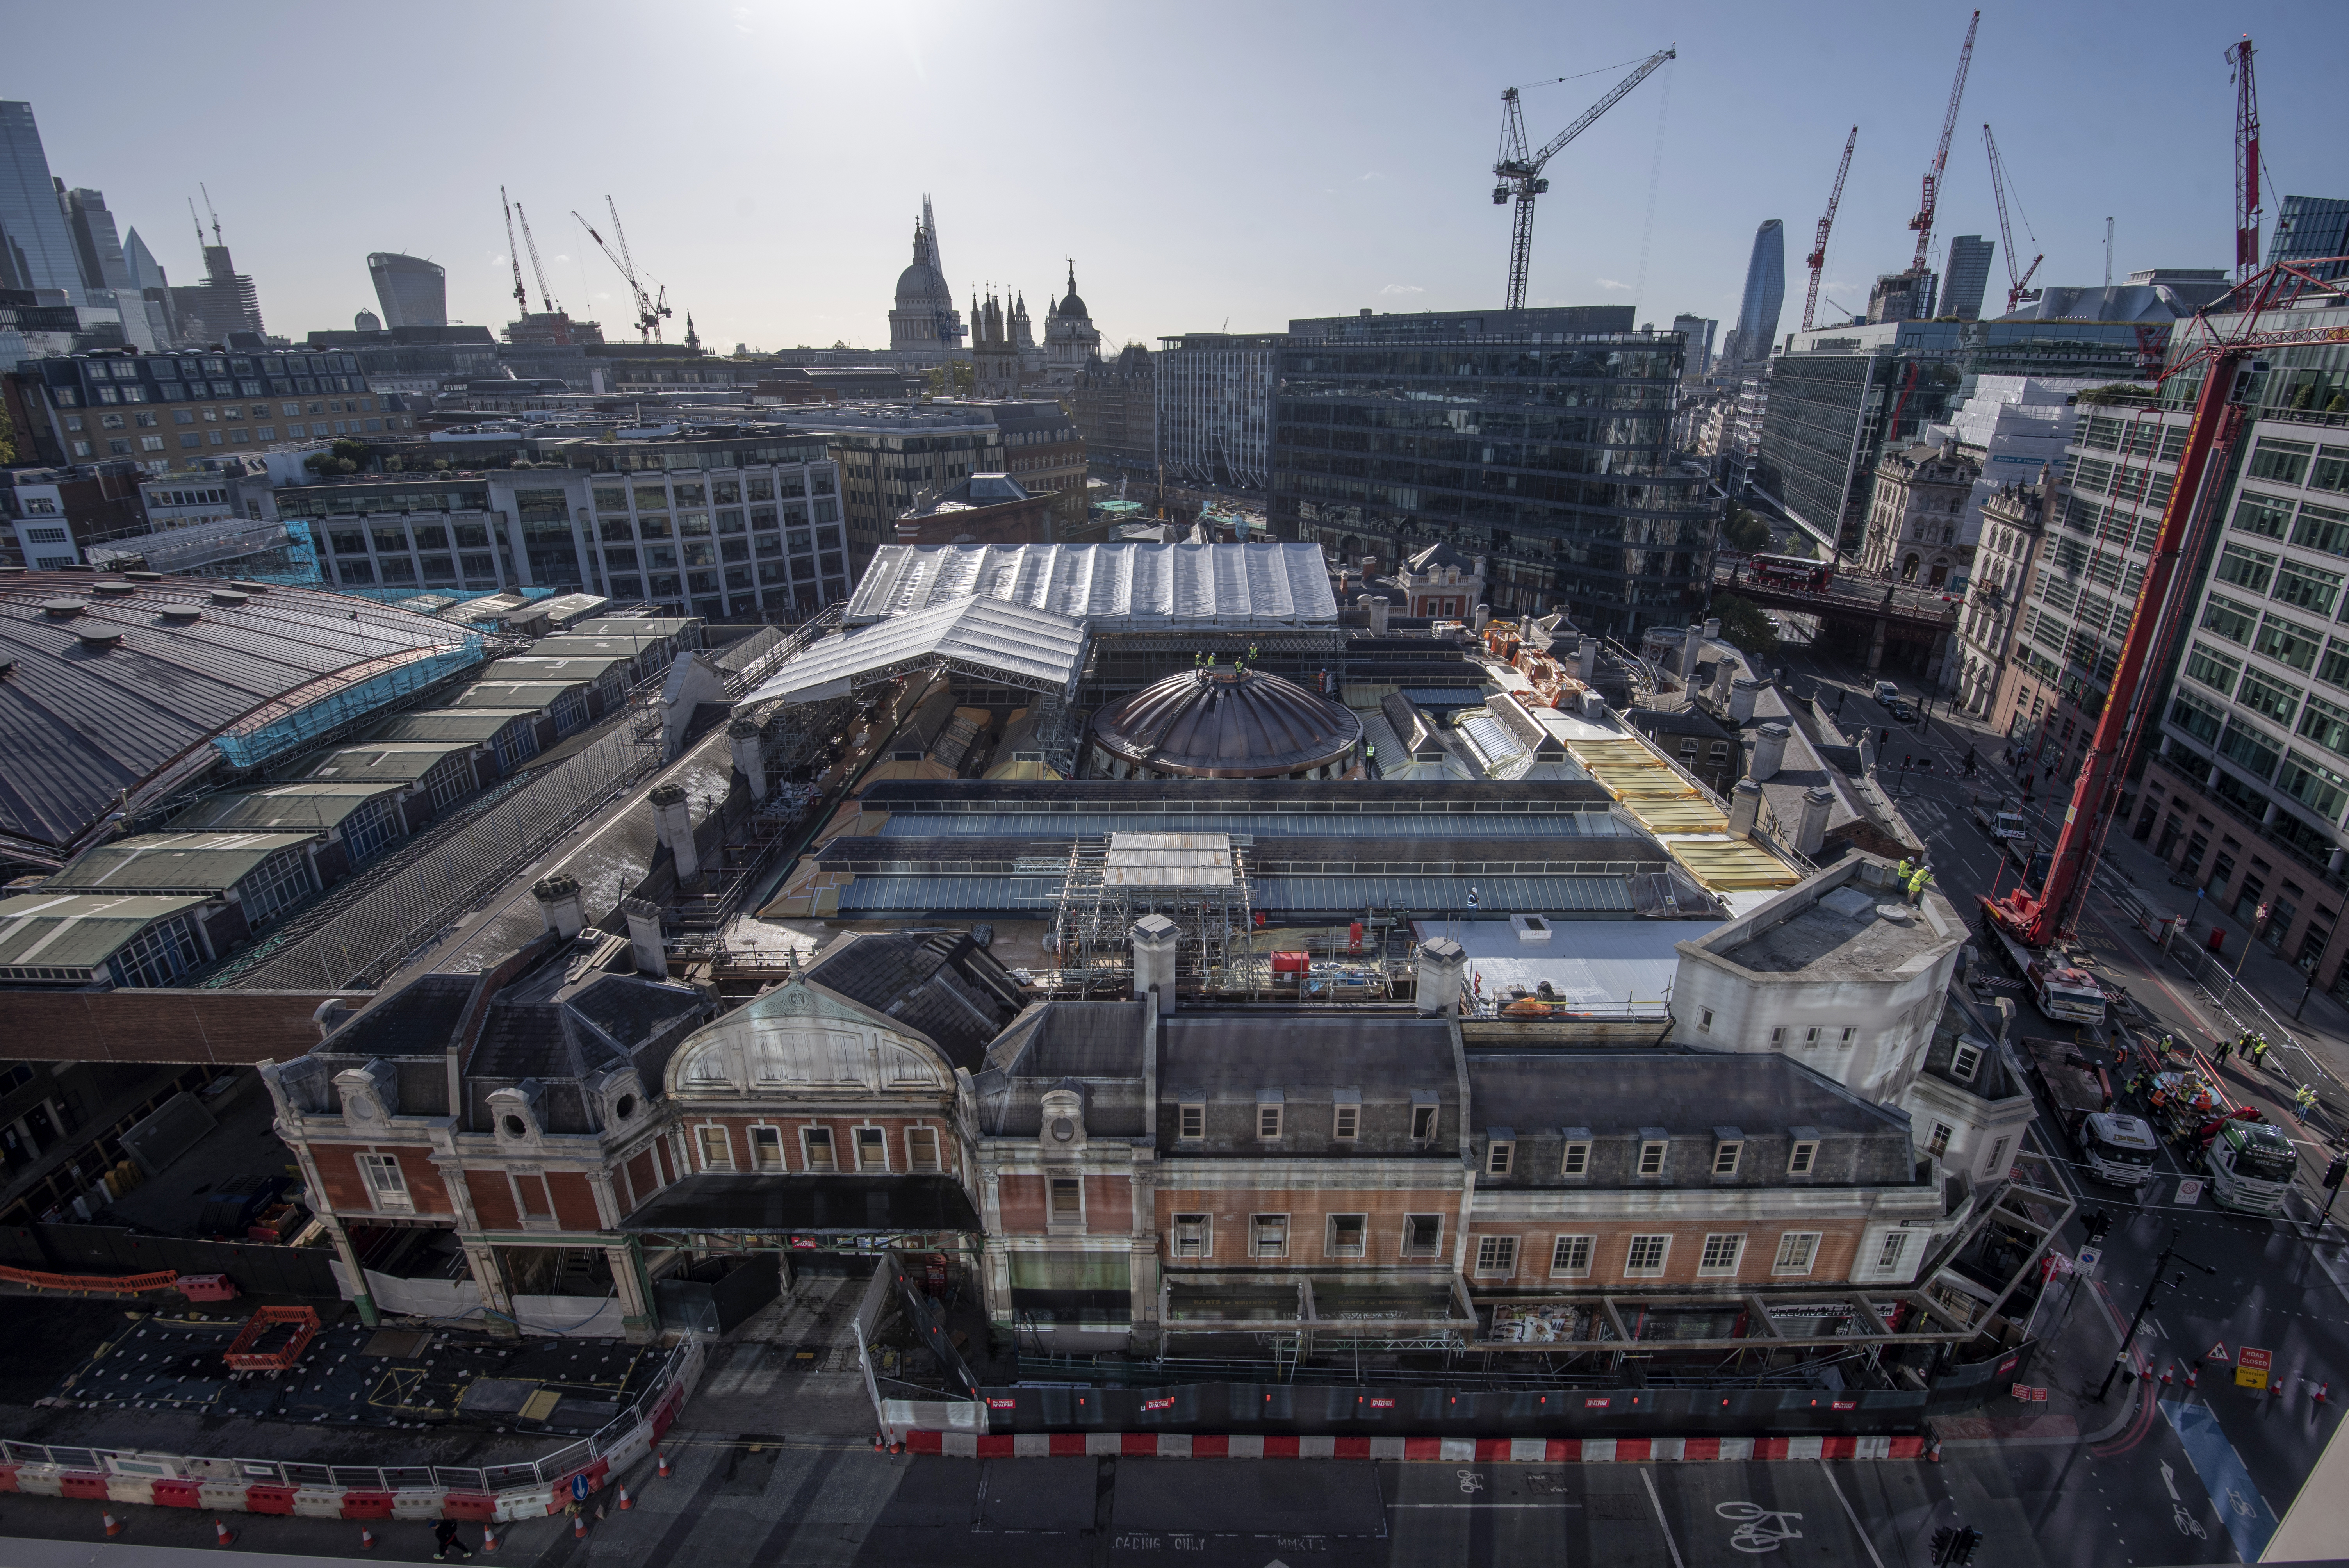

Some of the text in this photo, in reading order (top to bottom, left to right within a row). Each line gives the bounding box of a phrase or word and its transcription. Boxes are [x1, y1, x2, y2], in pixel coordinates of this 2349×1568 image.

[2160, 413, 2201, 536] CITY LIFTING
[2104, 590, 2146, 712] CITY LIFTING
[2080, 935, 2119, 950] BUS
[2255, 1159, 2282, 1168] HAULAGE
[2242, 1358, 2267, 1366] CLOSED
[1109, 1536, 1205, 1550] OADING ONLY
